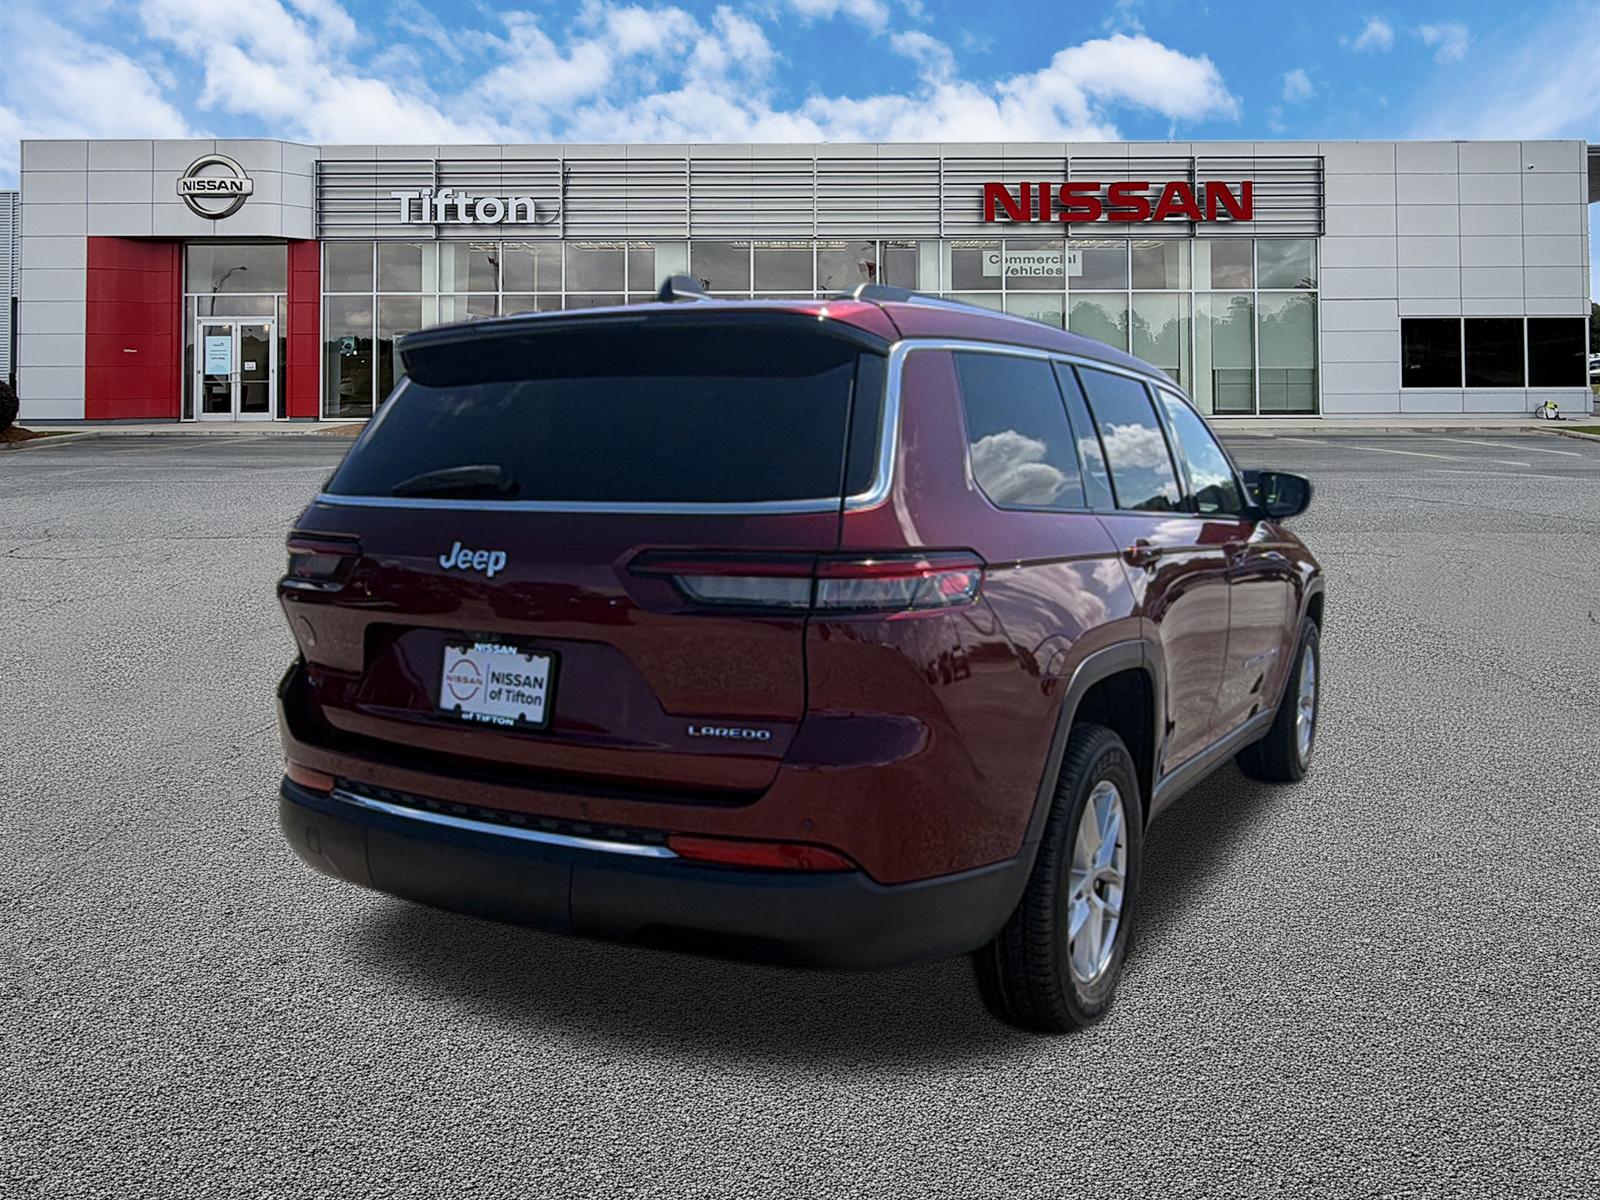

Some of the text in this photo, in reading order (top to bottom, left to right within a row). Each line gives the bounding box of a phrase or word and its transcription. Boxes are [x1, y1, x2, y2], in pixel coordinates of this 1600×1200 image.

[182, 180, 243, 191] NISSAN
[391, 188, 536, 224] Tifton
[983, 181, 1253, 222] NISSAN
[440, 541, 507, 577] Jeep
[474, 643, 518, 655] NISSAN
[446, 675, 483, 686] NISSAN
[490, 671, 544, 689] NISSAN
[489, 688, 542, 706] of Tifton
[476, 714, 514, 726] TIFTON
[688, 725, 771, 740] LAREDO
